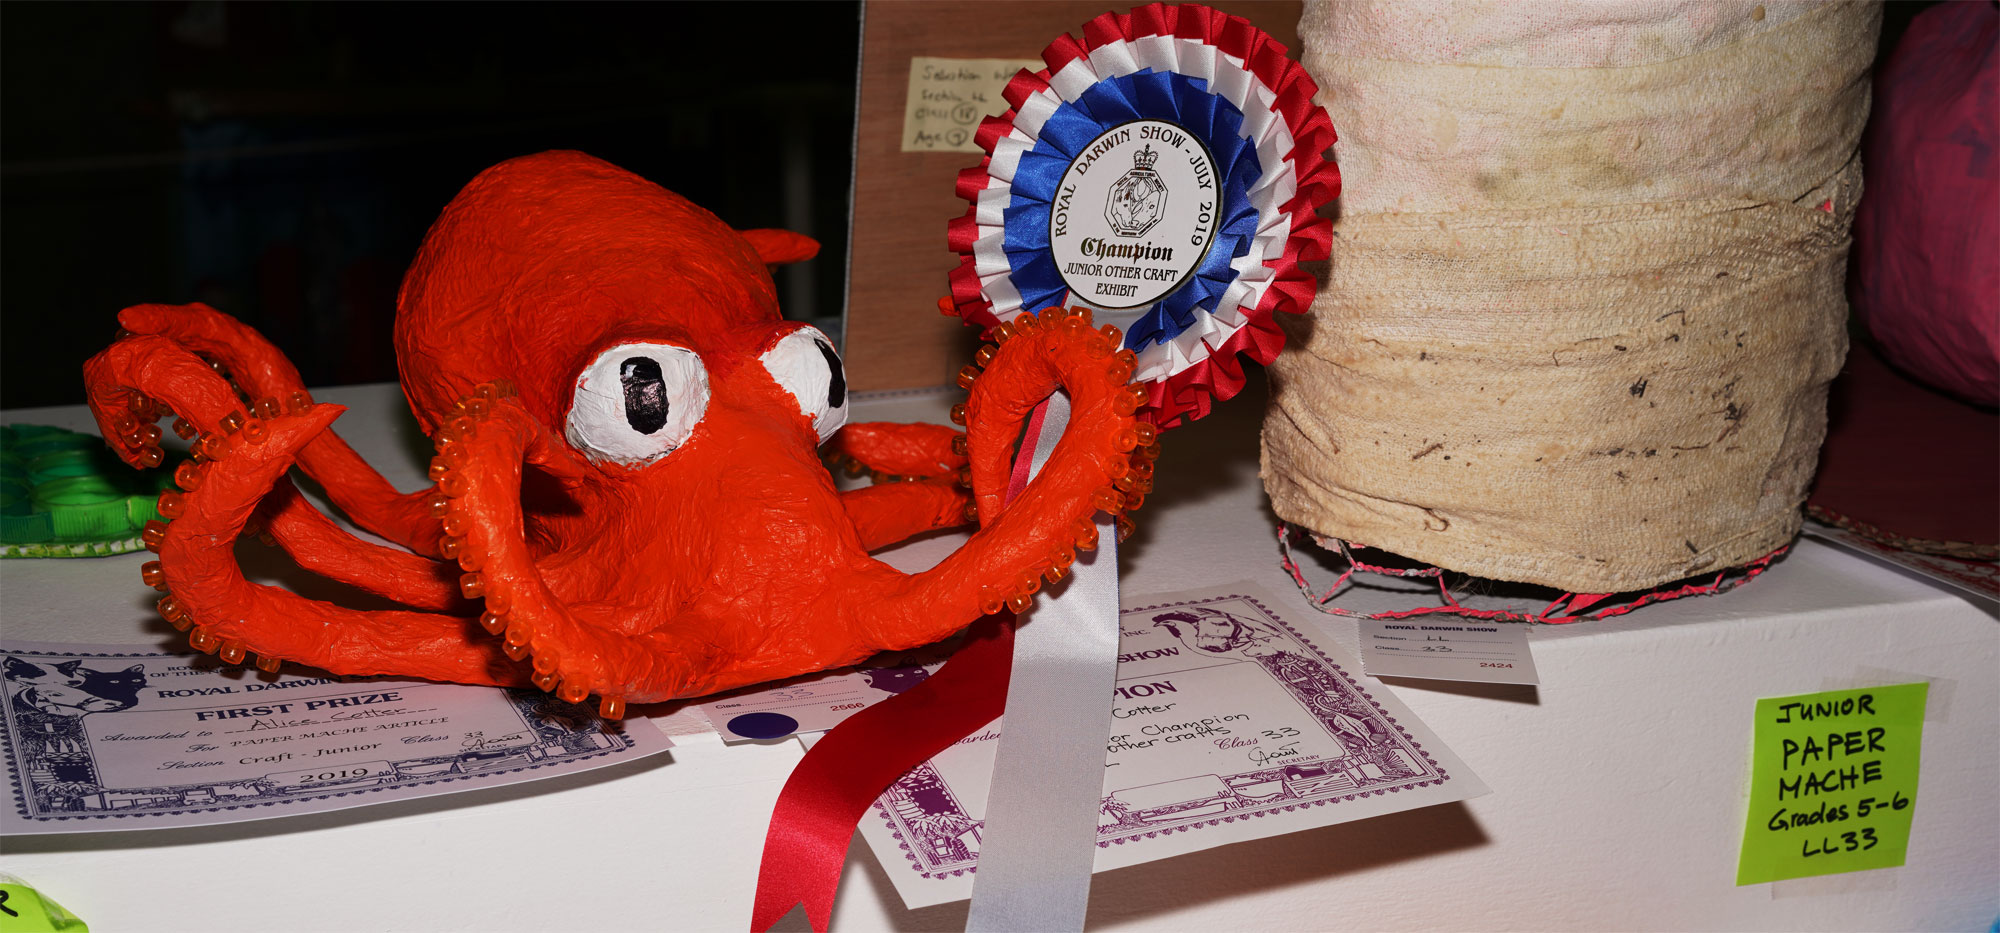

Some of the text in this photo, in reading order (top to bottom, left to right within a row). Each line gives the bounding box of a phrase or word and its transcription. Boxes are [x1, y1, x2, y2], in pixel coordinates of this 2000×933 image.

[913, 130, 942, 148] Age
[1140, 125, 1187, 149] SHOW
[1075, 129, 1131, 176] DARWIN
[1189, 156, 1212, 190] JULY
[1056, 184, 1077, 237] ROYAL
[1191, 201, 1212, 246] 2019
[1080, 237, 1173, 265] Champion
[1064, 263, 1178, 282] JUNIOR OTHER CRAFT
[1095, 282, 1138, 297] EXHIBIT
[1117, 647, 1179, 663] SHOW
[157, 686, 240, 698] ROYAL
[245, 677, 342, 692] DARWIN
[769, 689, 814, 700] 33
[195, 692, 403, 721] FIRST PRIZE
[1112, 703, 1176, 719] Cotter
[1776, 694, 1876, 723] JUNIOR
[185, 717, 449, 753] For PAPER MACHE ARTICLE
[250, 718, 316, 730] Alice
[1141, 713, 1250, 736] Champion
[100, 730, 190, 742] Awarded
[400, 731, 484, 745] Class 33
[1107, 739, 1159, 753] other
[1165, 726, 1231, 743] crafts
[1214, 727, 1301, 750] Class 33
[157, 760, 226, 771] Section
[239, 752, 293, 765] Craft
[313, 742, 382, 758] Junior
[1277, 754, 1320, 765] SECRETARY
[1782, 727, 1886, 771] PAPER
[300, 768, 368, 783] 2019
[1779, 760, 1883, 801] MACHE
[1767, 791, 1910, 831] Grades 5-6
